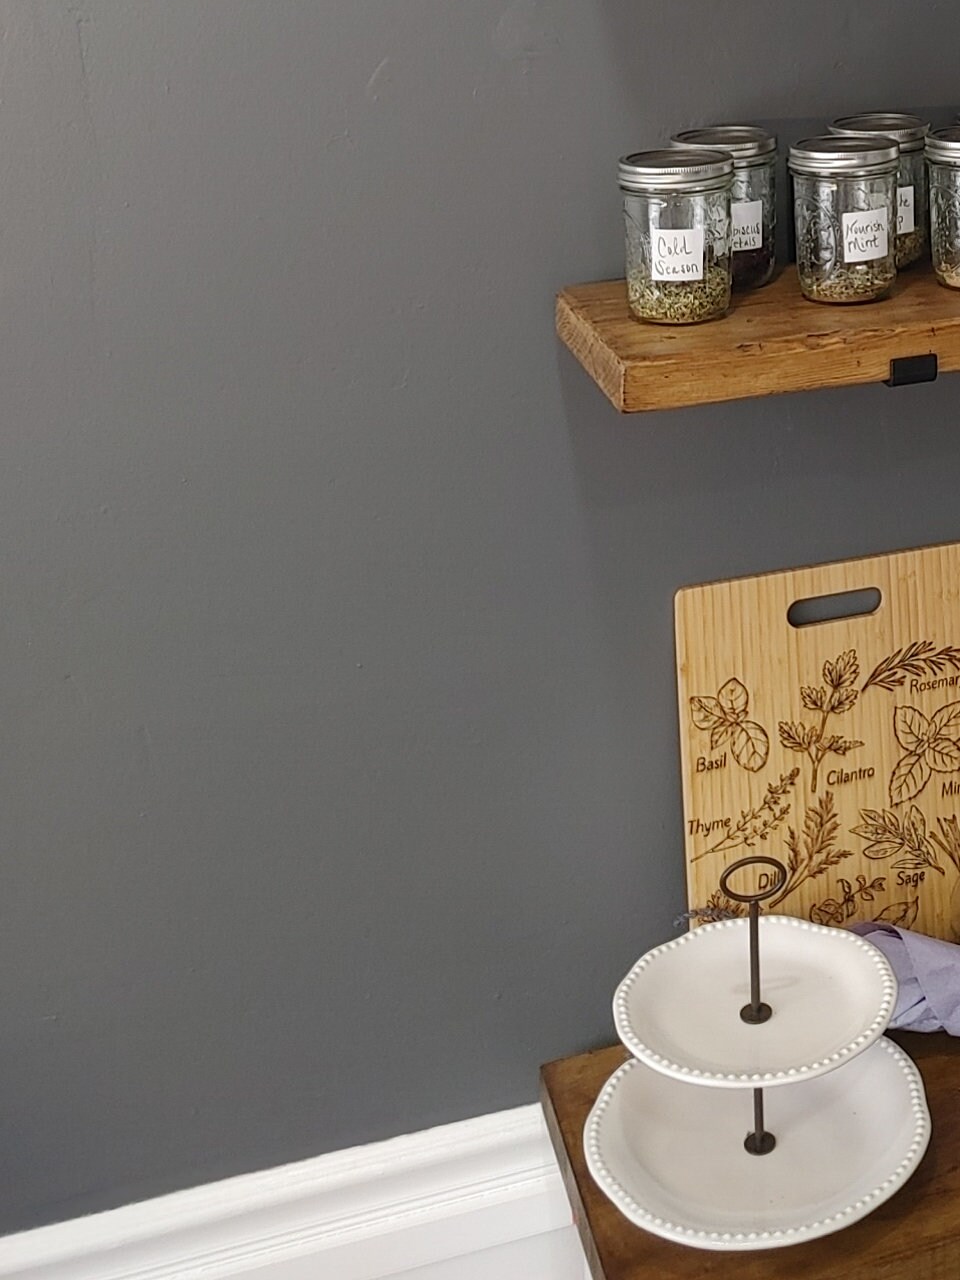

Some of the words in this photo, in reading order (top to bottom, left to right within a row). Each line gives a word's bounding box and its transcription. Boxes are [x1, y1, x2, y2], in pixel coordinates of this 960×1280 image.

[846, 219, 885, 238] Nourish
[657, 235, 693, 258] Cold
[731, 237, 756, 249] etals
[848, 234, 880, 253] Mint
[654, 260, 699, 276] Season
[695, 752, 727, 772] Basil
[826, 766, 875, 786] Cilantro
[688, 816, 731, 837] Thyme
[758, 870, 780, 890] Dill
[896, 870, 926, 888] Sage
